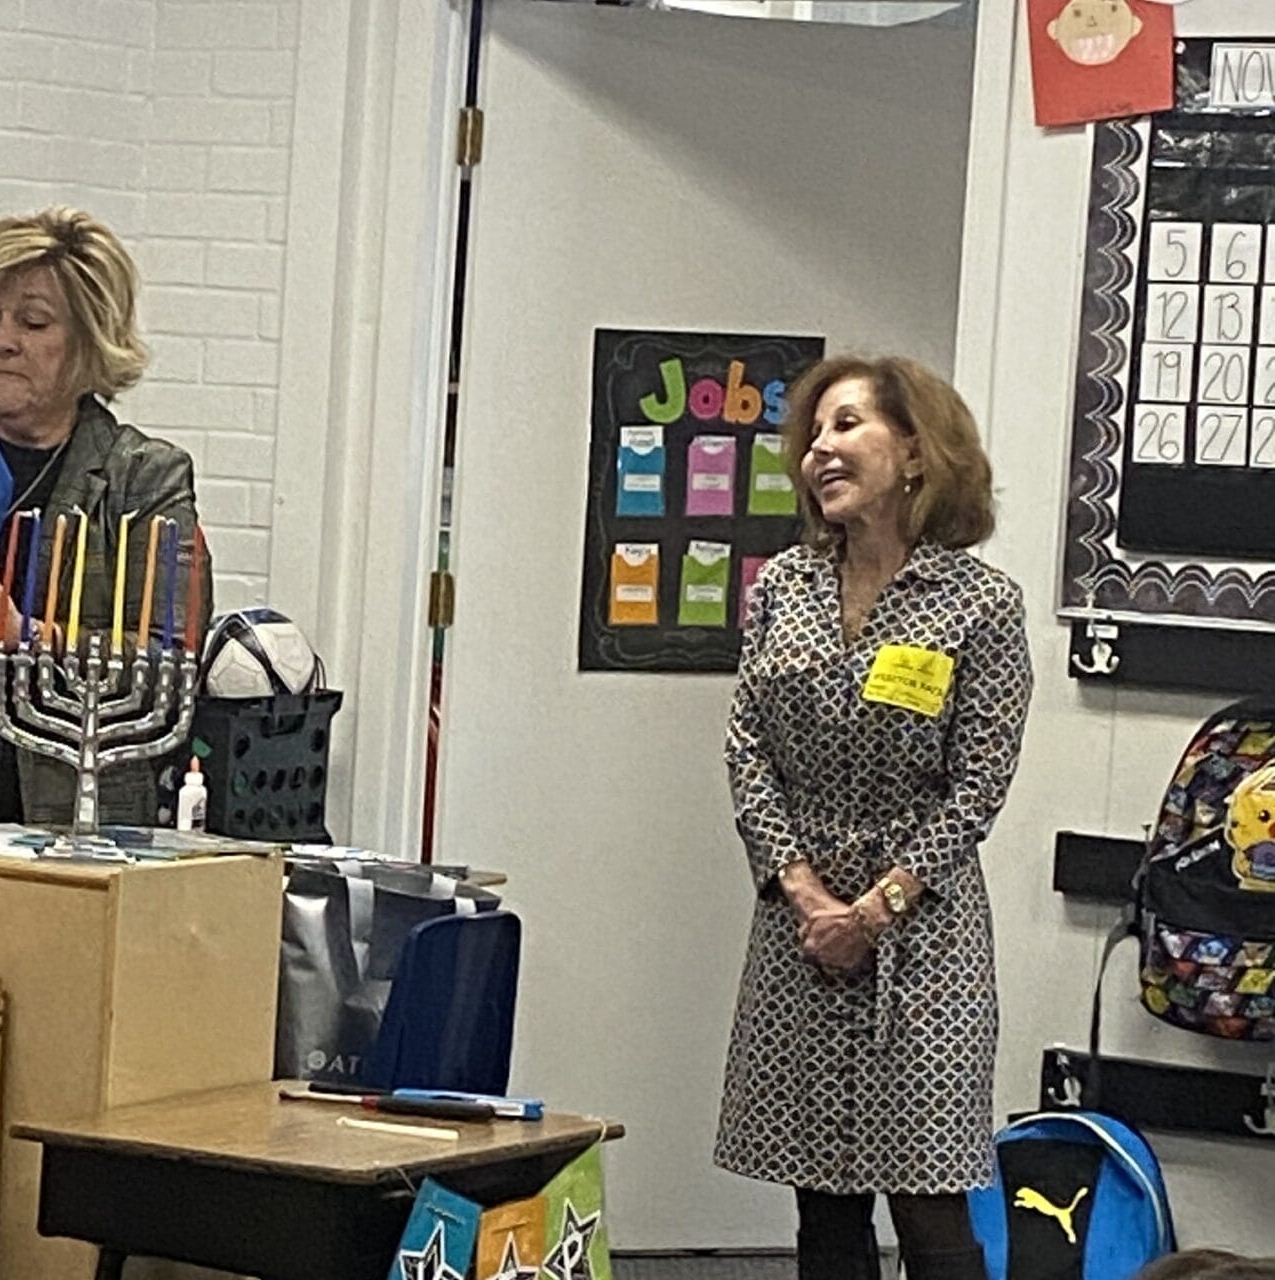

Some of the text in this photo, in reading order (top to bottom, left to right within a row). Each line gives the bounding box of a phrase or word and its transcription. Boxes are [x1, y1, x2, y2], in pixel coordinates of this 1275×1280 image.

[1220, 50, 1275, 103] NO
[1164, 230, 1247, 279] 5 6
[1156, 291, 1243, 341] 12 13
[639, 358, 789, 424] Jobs
[1153, 351, 1182, 398] 19
[1202, 352, 1245, 402] 20
[1138, 411, 1275, 464] 26 27 2
